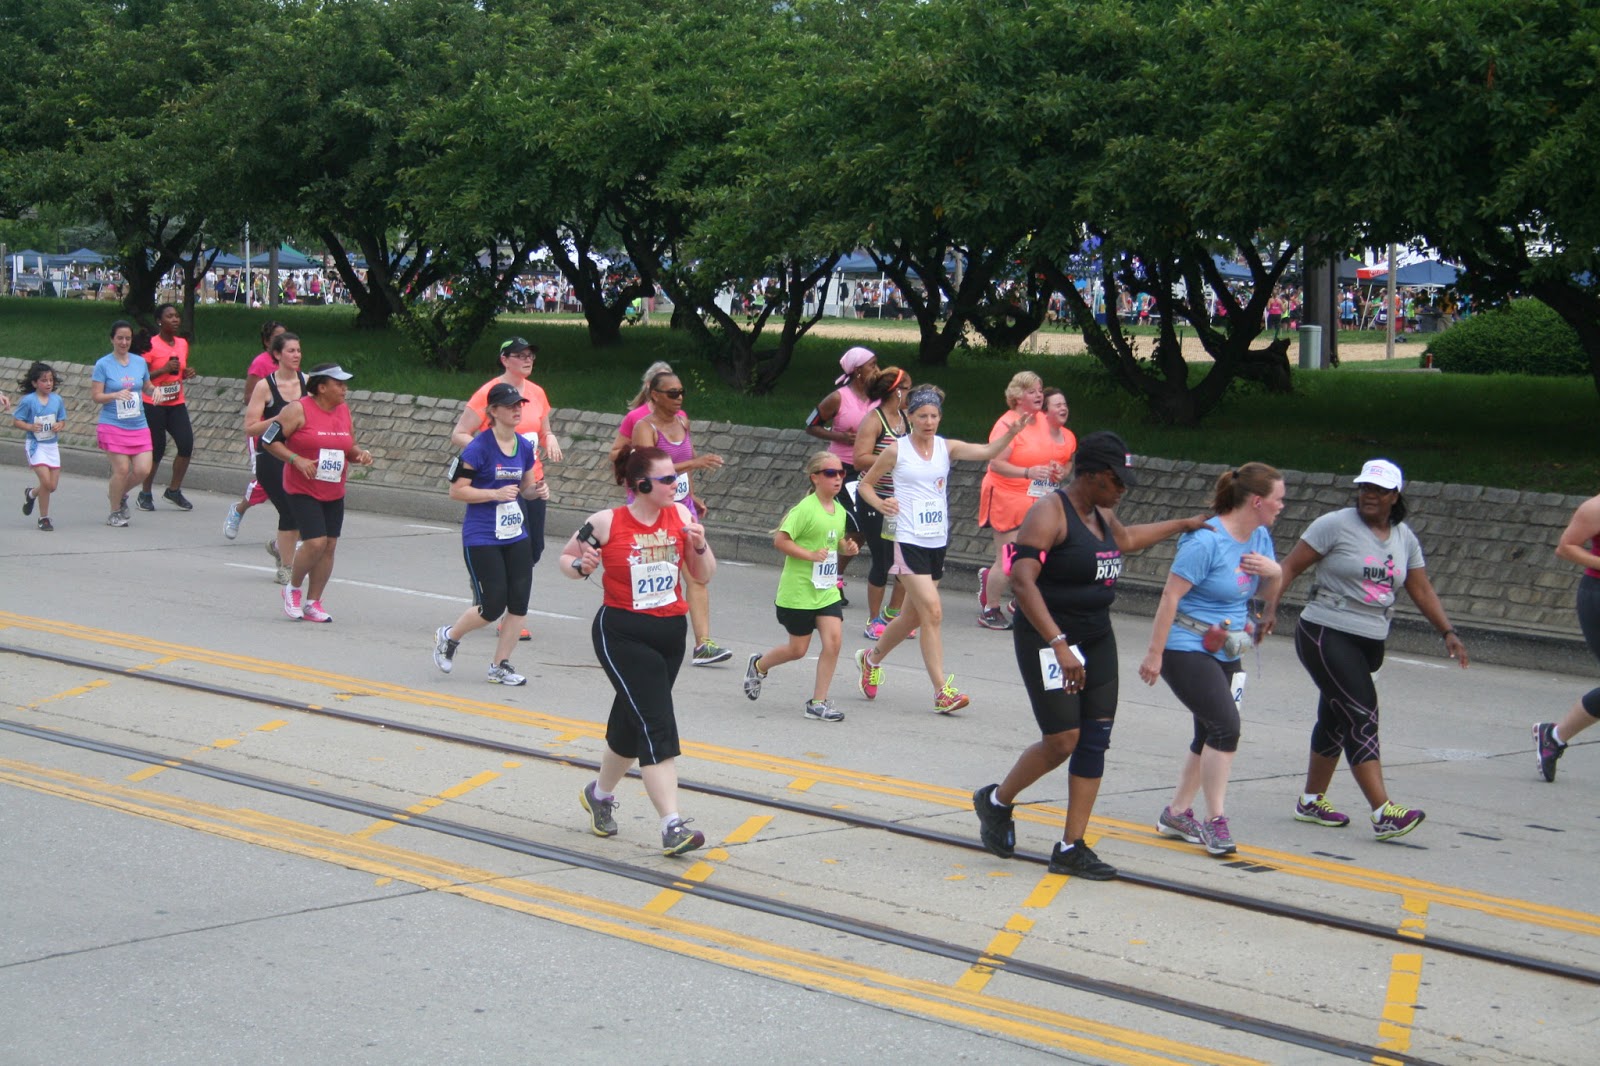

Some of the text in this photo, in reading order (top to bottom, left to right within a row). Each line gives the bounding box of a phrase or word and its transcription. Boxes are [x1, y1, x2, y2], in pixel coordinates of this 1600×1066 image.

[122, 400, 136, 410] 102
[321, 460, 342, 471] 3545
[500, 513, 522, 527] 2556
[918, 511, 943, 524] 1028
[646, 564, 662, 573] BWC
[1095, 565, 1122, 580] RUN
[1363, 567, 1386, 580] RUN
[638, 575, 674, 594] 2122
